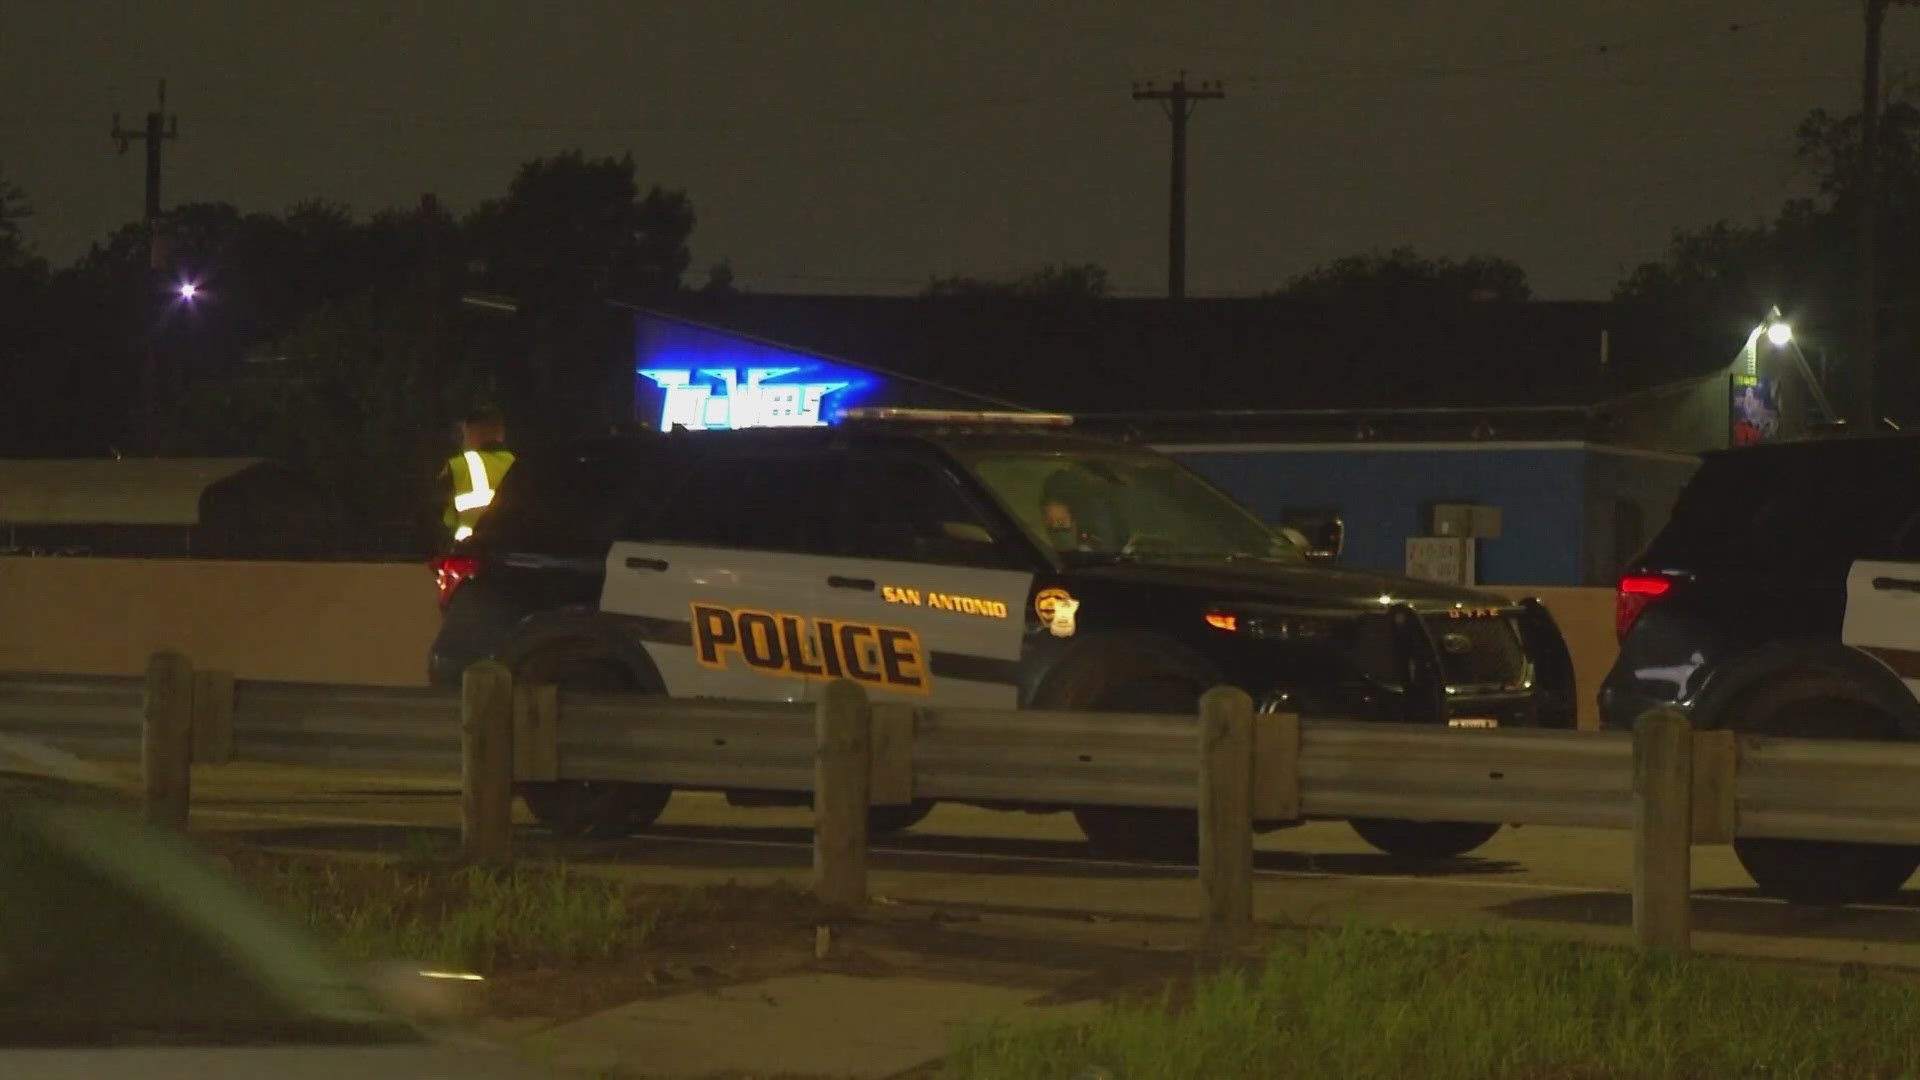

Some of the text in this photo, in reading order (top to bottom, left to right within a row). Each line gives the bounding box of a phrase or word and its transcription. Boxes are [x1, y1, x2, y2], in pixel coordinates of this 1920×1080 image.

[882, 586, 1007, 618] SAN ANTONIO
[692, 603, 928, 692] POLICE
